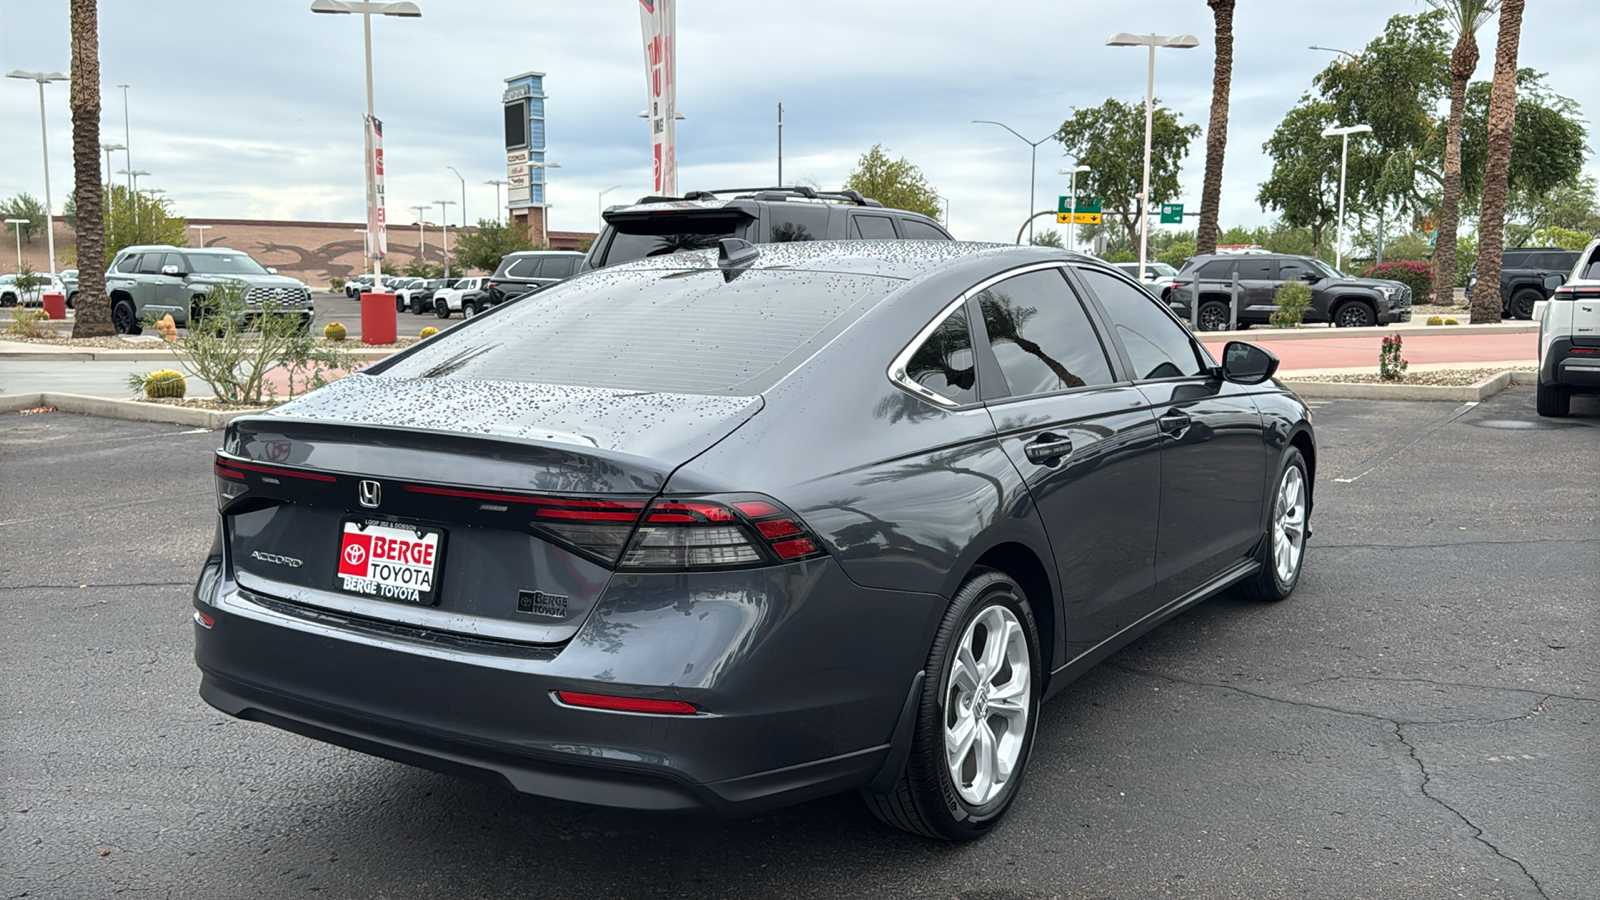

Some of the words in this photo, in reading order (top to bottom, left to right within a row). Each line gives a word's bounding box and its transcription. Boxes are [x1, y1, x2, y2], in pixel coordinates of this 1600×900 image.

[364, 519, 380, 527] LOOP
[394, 523, 417, 531] DOBSON
[250, 550, 303, 568] ACCORD
[372, 535, 434, 566] BERGE
[371, 563, 431, 587] TOYOTA
[343, 576, 378, 595] BERGE
[380, 584, 419, 602] TOYOTA
[534, 591, 568, 607] BERGE
[533, 605, 566, 617] TOYOTA
